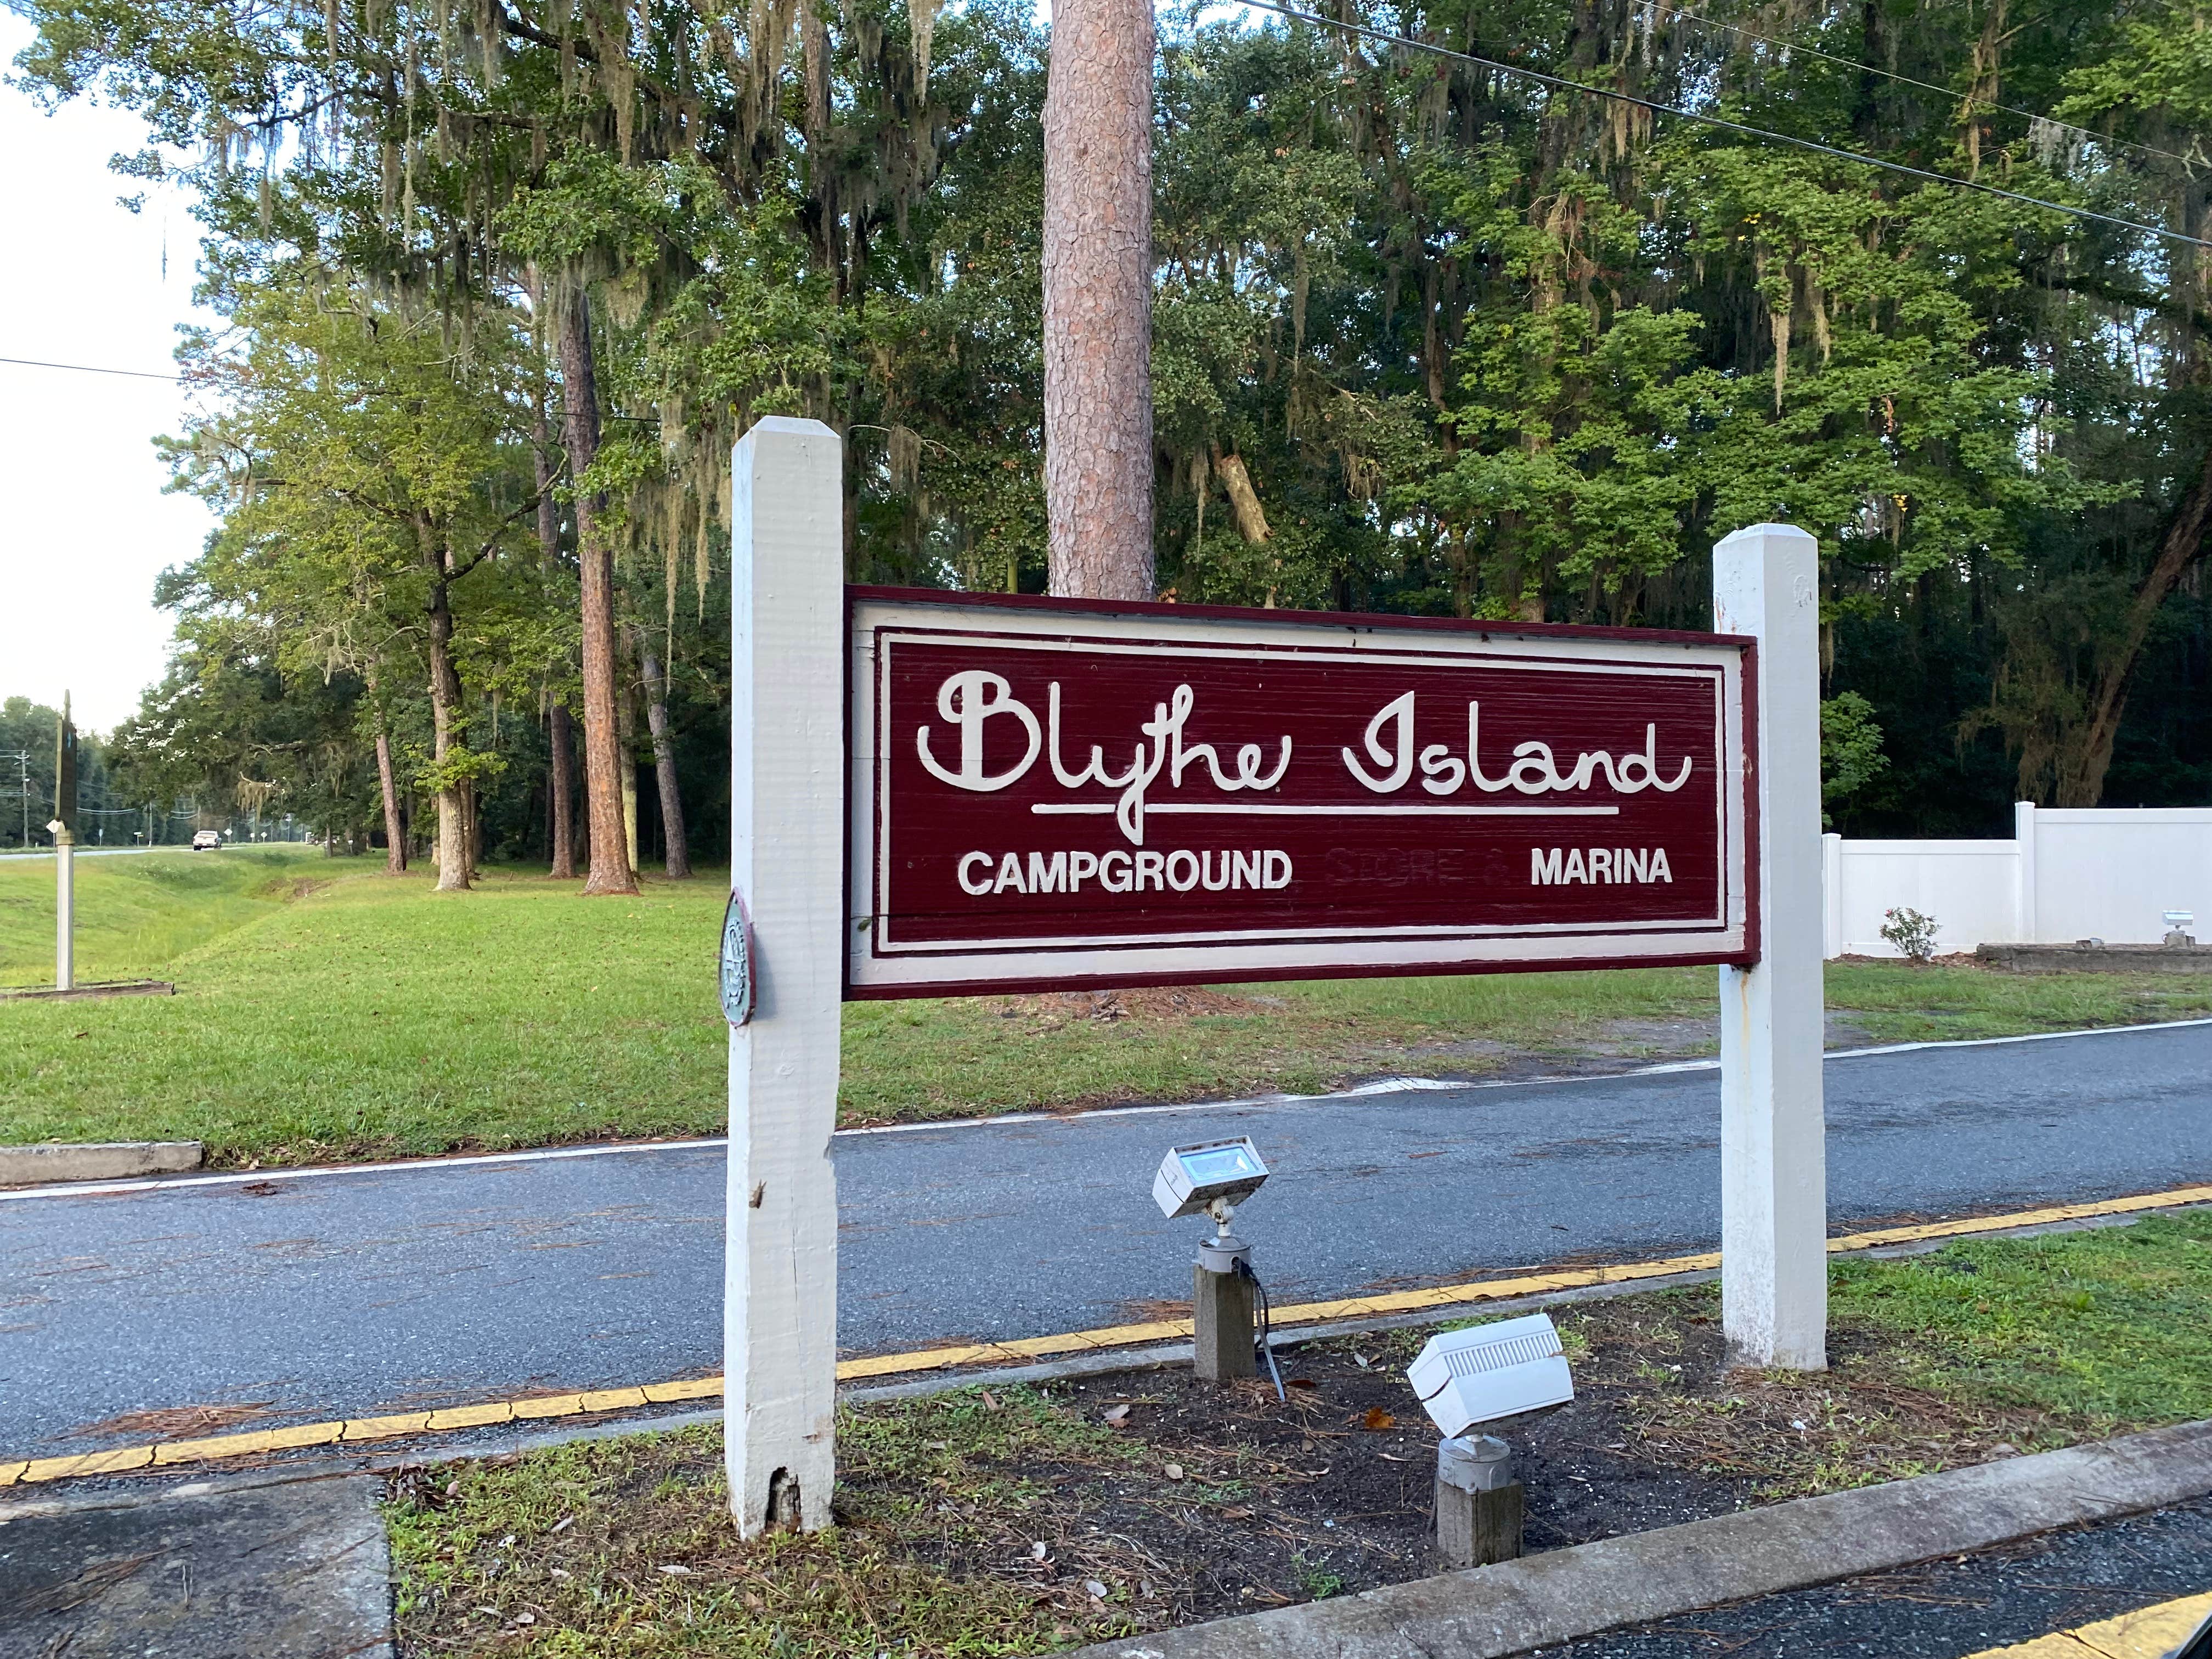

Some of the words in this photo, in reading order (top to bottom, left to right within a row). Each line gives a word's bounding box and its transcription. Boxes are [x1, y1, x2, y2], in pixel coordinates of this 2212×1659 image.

[916, 670, 1292, 846] Blythe
[1342, 690, 1692, 795] Island
[957, 849, 1293, 895] CAMPGROUND
[1531, 848, 1673, 885] MARINA
